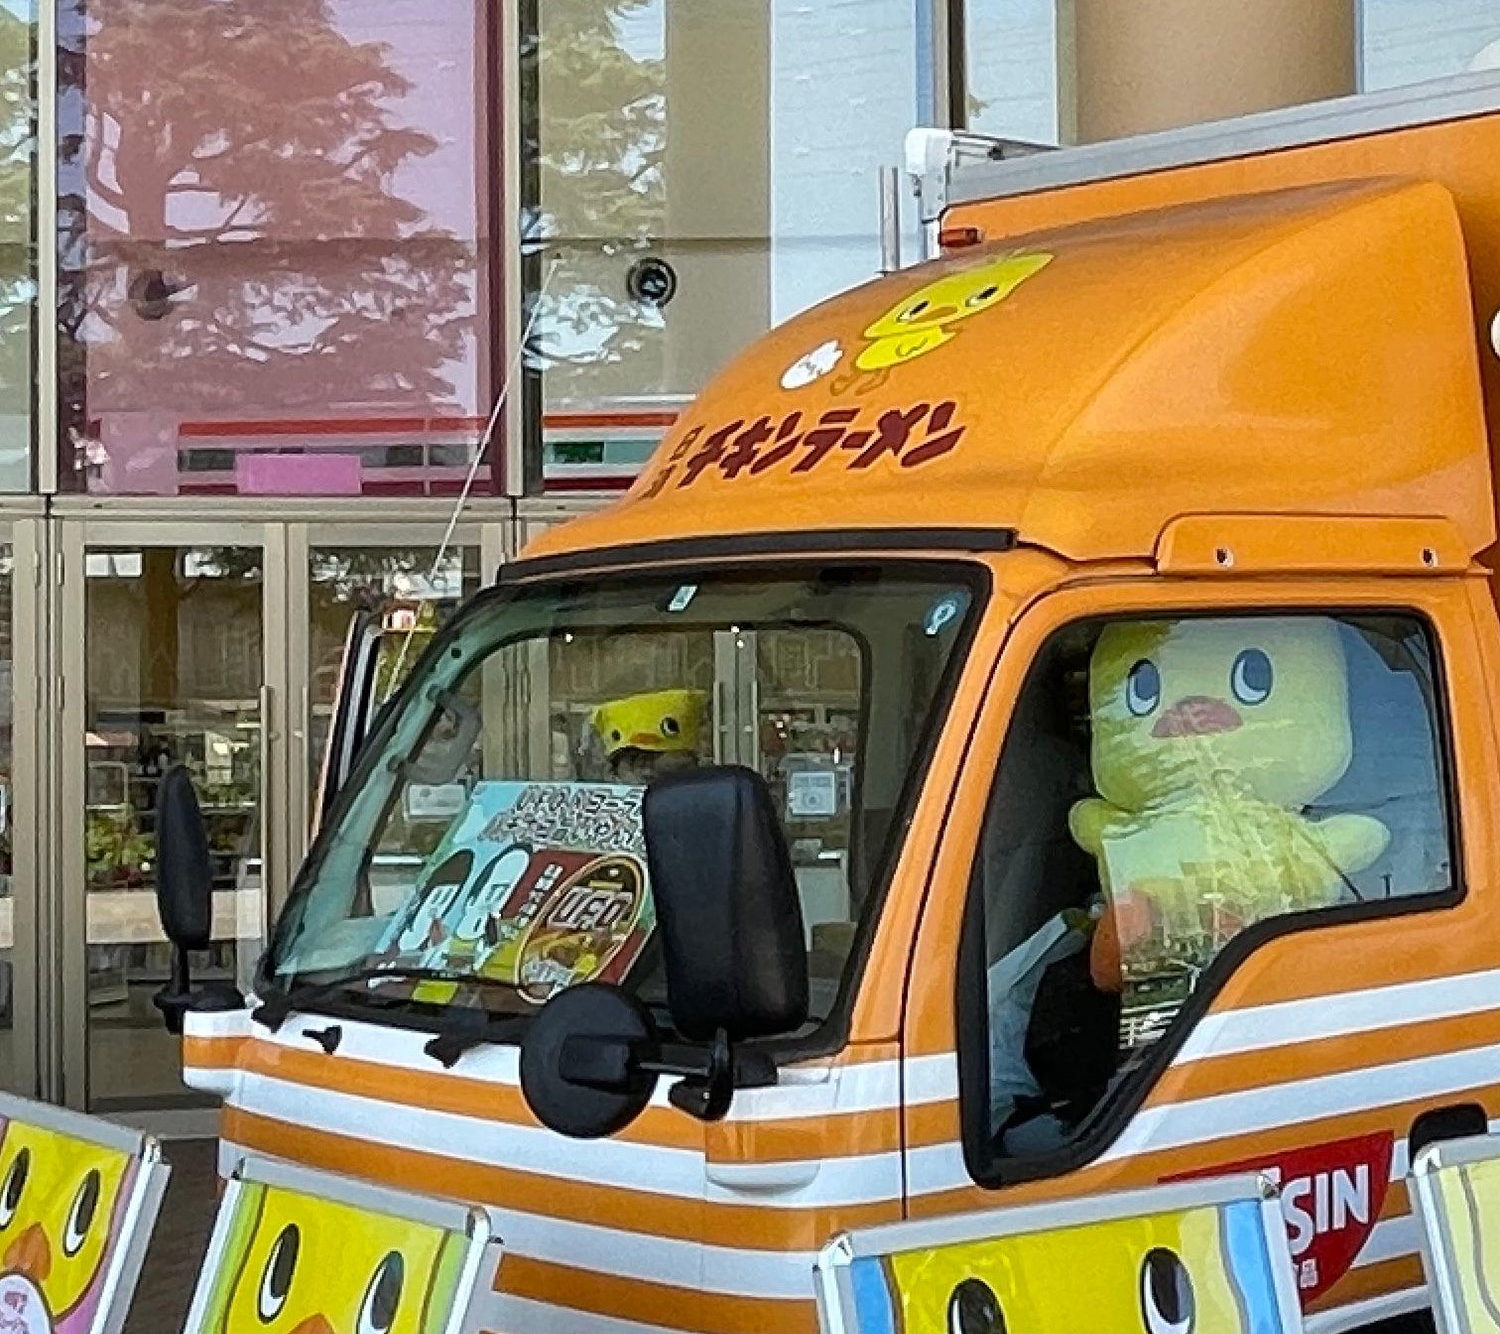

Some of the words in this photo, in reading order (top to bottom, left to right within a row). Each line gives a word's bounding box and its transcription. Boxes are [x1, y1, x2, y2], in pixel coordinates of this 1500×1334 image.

[675, 400, 967, 489] チキンラーメン
[1262, 1163, 1369, 1257] SIN
